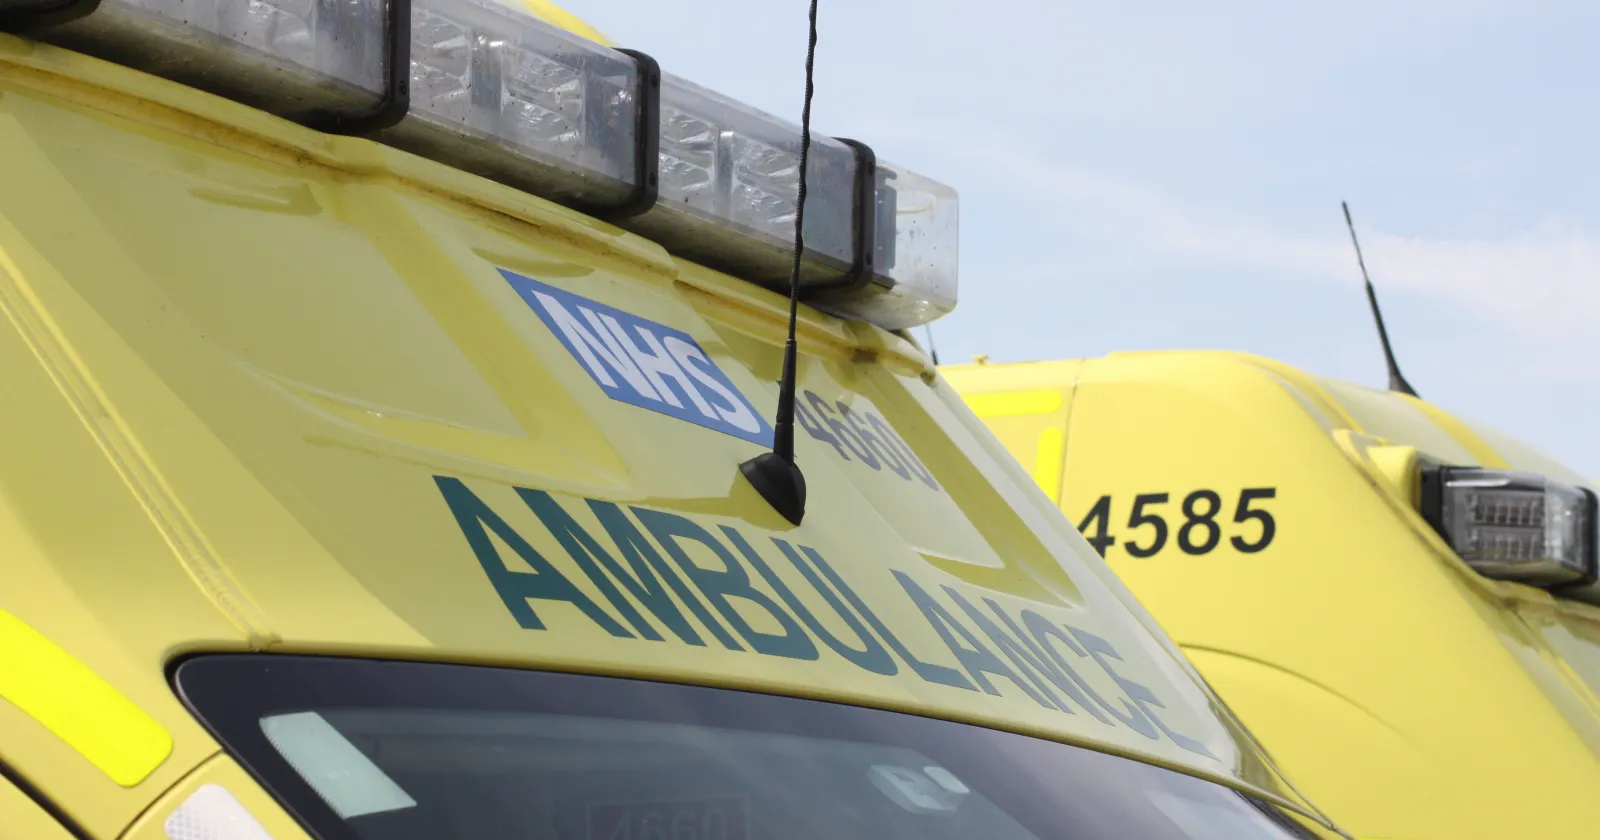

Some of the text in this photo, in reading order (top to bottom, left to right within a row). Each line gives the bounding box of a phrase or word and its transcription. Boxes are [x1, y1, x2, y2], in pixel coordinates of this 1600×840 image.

[532, 289, 761, 434] NHS
[793, 389, 939, 492] 4660
[1077, 487, 1277, 559] 4585
[432, 475, 1222, 763] AMBULANCE
